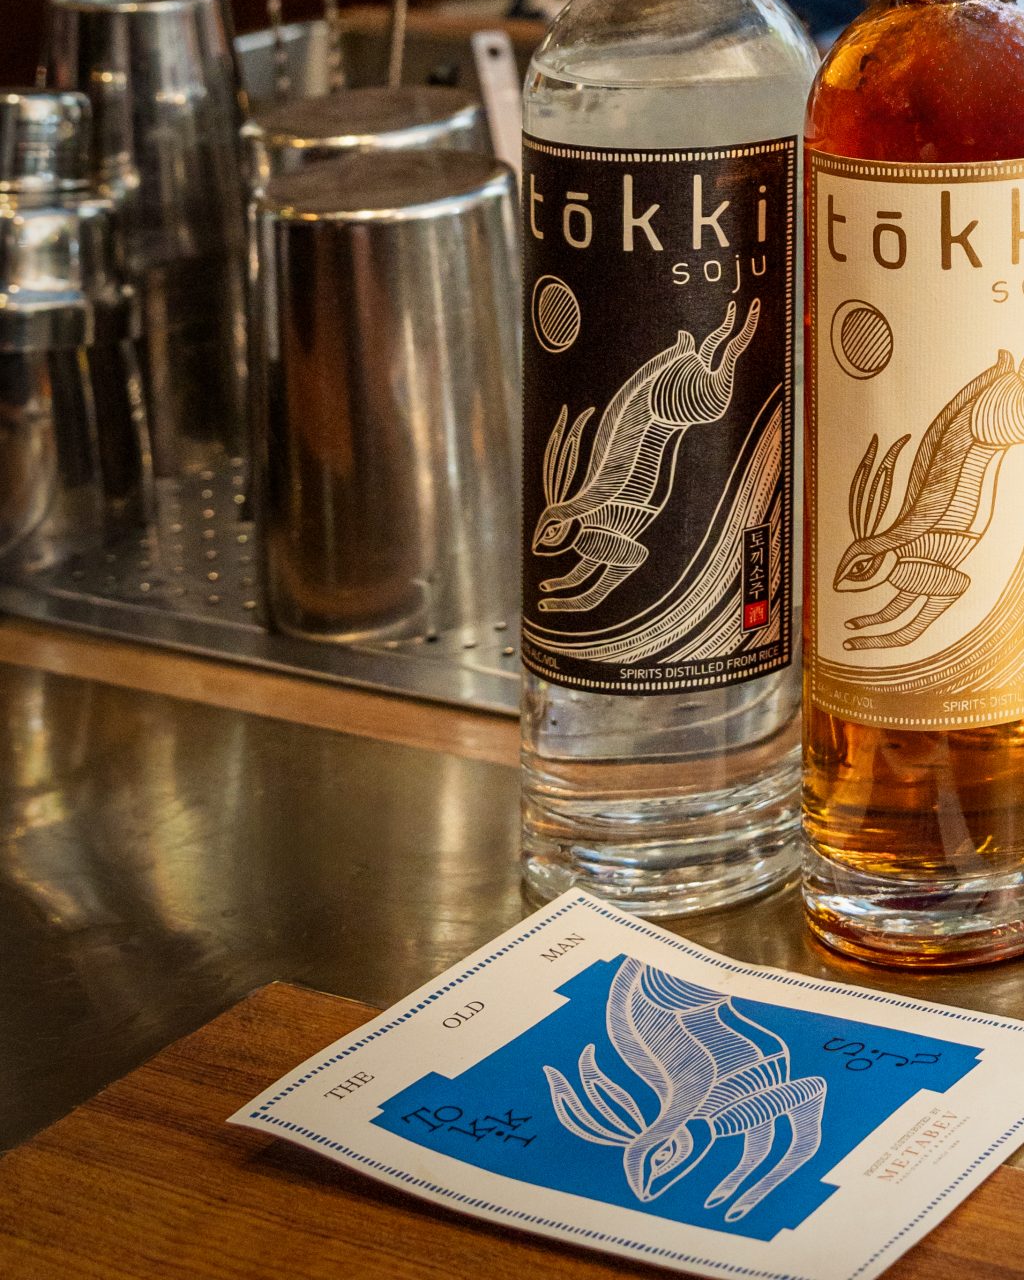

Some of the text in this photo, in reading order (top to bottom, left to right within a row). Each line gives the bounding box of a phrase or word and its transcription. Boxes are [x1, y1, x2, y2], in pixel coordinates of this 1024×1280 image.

[529, 173, 767, 253] tōkki
[671, 251, 767, 294] soju
[749, 530, 765, 600] 토끼소주
[620, 645, 779, 679] SPIRITS DISTILLED FROM RICE
[943, 698, 986, 712] SPIRITS
[323, 933, 586, 1101] THE OLD MAN
[877, 1110, 958, 1182] METABEV
